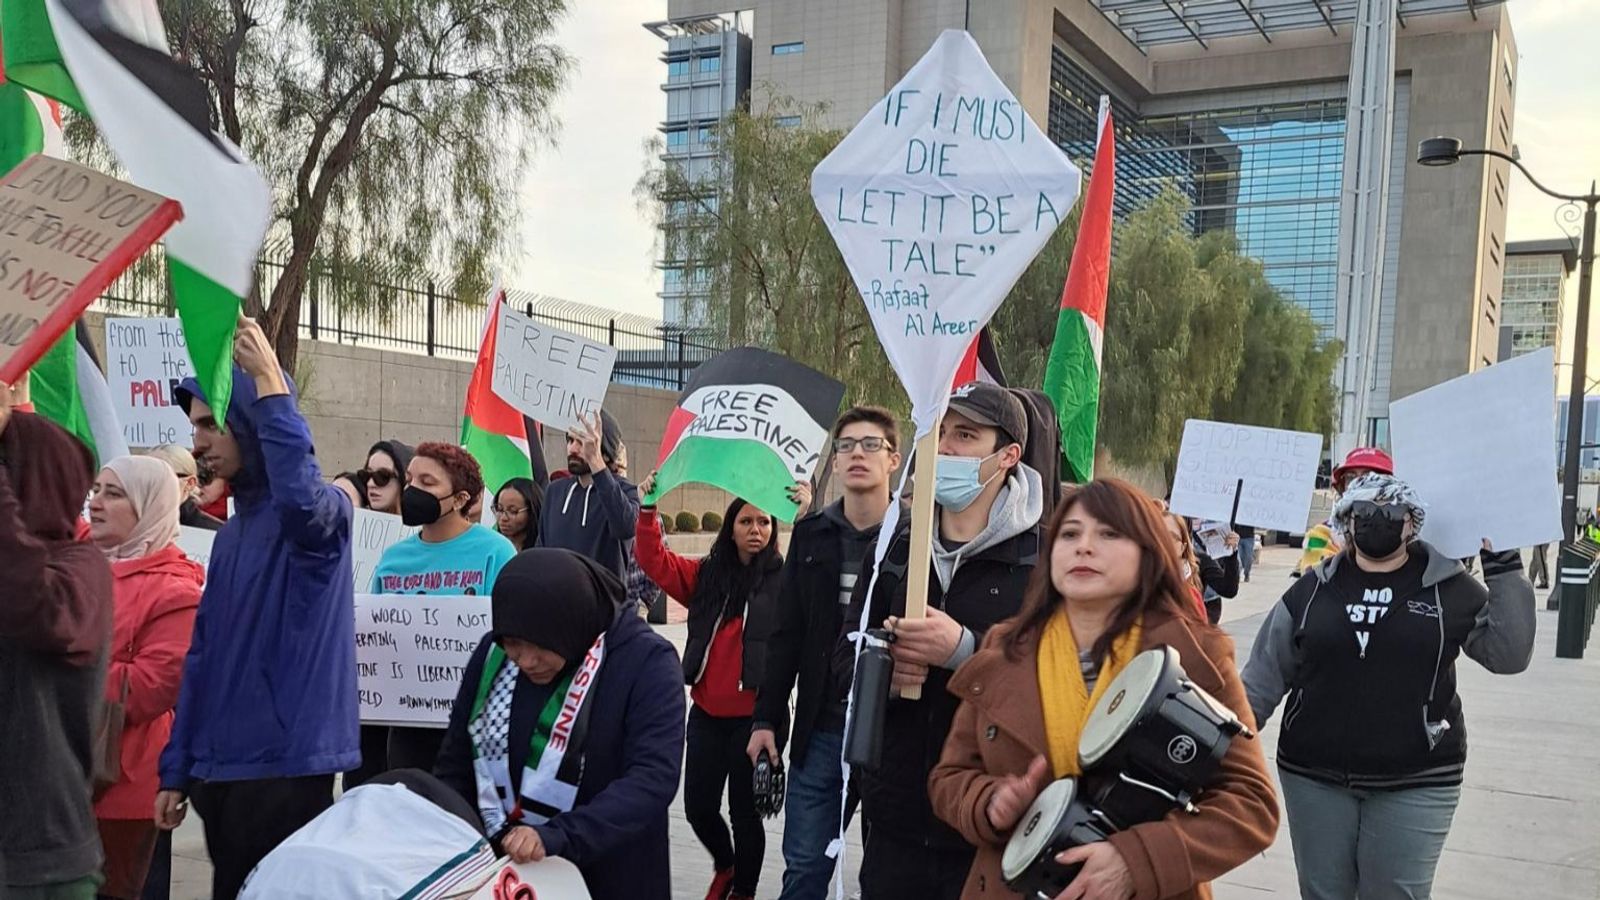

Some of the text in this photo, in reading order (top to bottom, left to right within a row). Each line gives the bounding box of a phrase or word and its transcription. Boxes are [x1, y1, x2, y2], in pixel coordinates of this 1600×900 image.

[884, 89, 1026, 143] IF I MUST
[904, 138, 959, 177] DIE
[84, 184, 158, 228] YOU
[837, 187, 1061, 235] LET IT BE A
[48, 223, 112, 263] KILL
[9, 267, 75, 307] NOT
[109, 321, 186, 348] from the
[904, 311, 979, 337] Al Areer
[504, 314, 607, 374] FREE
[119, 351, 187, 377] to the
[495, 352, 601, 422] PALESTINE
[701, 389, 779, 415] FREE
[158, 422, 177, 444] be
[1187, 423, 1308, 458] STOP THE
[1181, 448, 1307, 482] GENOCIDE
[1362, 587, 1393, 604] NO
[371, 607, 412, 626] WORLD
[423, 607, 439, 626] IS
[456, 613, 488, 628] NOT
[414, 633, 477, 653] PALESTINE
[391, 661, 404, 679] IS
[549, 640, 602, 752] ESTINE
